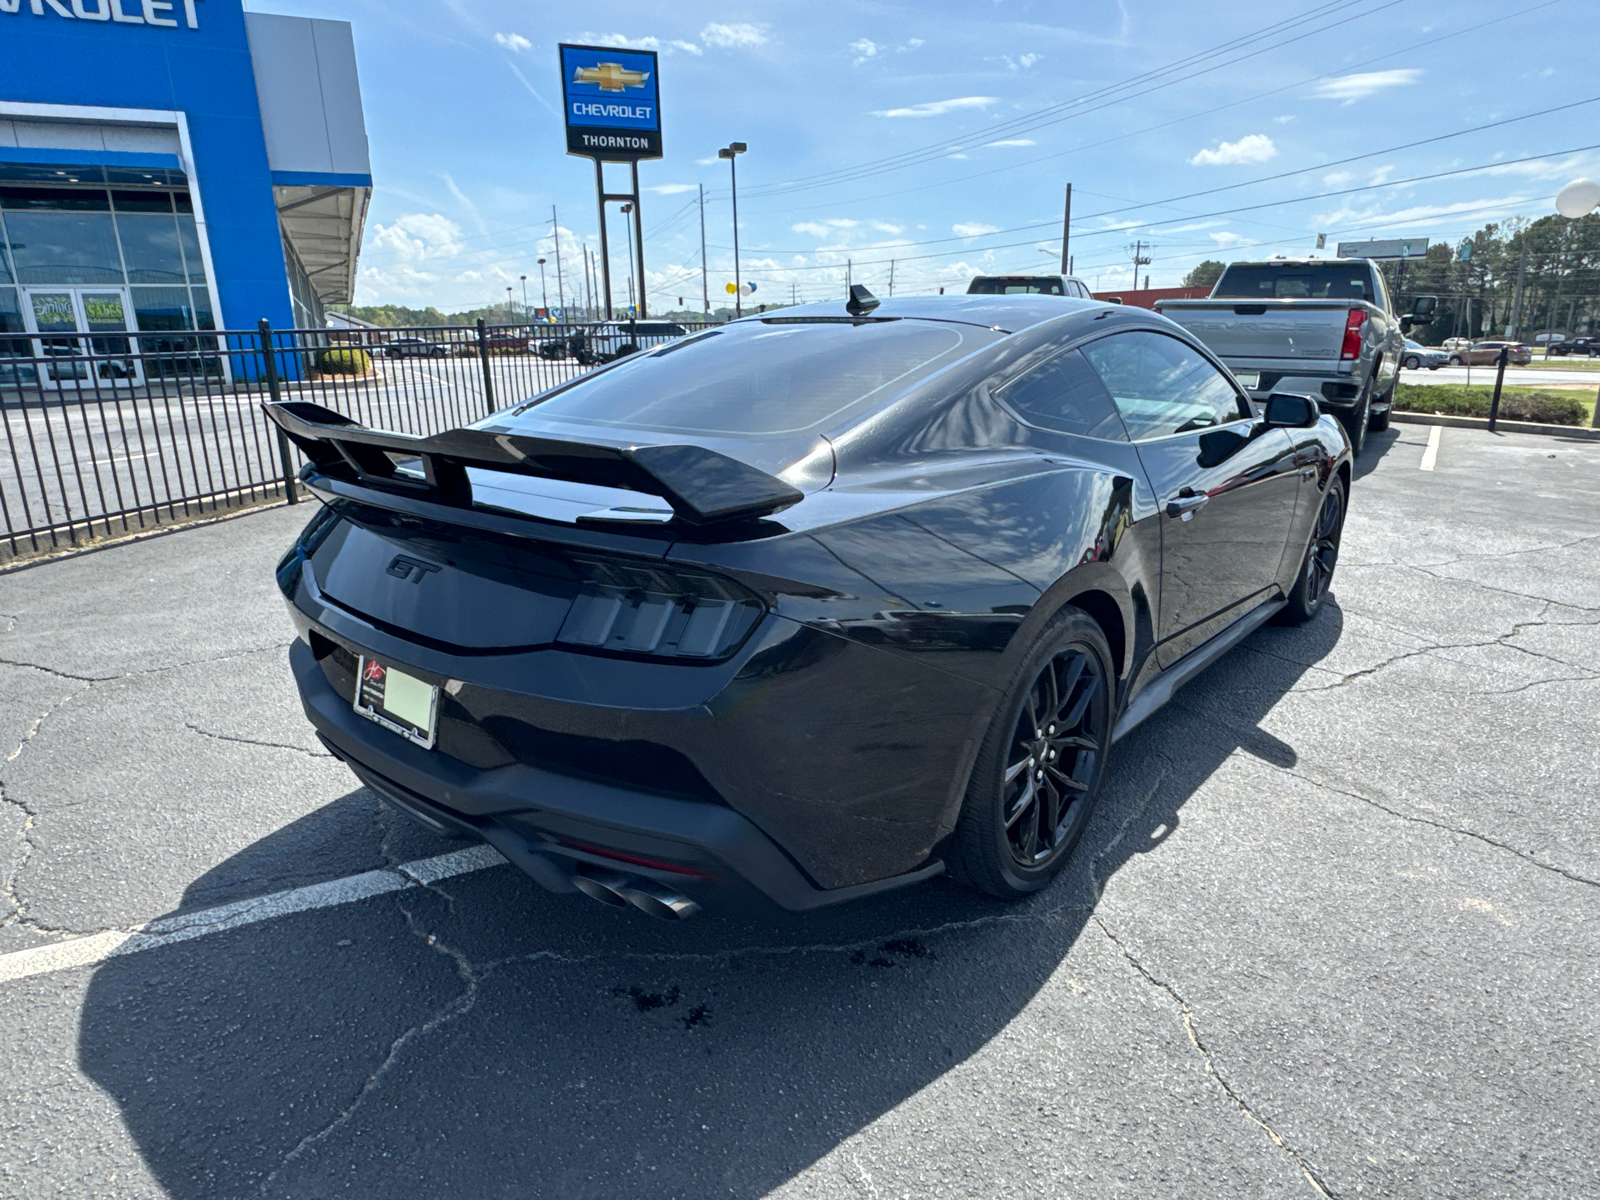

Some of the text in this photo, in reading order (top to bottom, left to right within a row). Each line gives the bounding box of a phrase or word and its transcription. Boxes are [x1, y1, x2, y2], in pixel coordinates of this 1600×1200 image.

[0, 0, 199, 28] OLET
[573, 103, 652, 119] CHEVROLET
[582, 135, 648, 149] THORNTON
[1178, 321, 1332, 333] HEVROLET
[386, 554, 443, 585] GT
